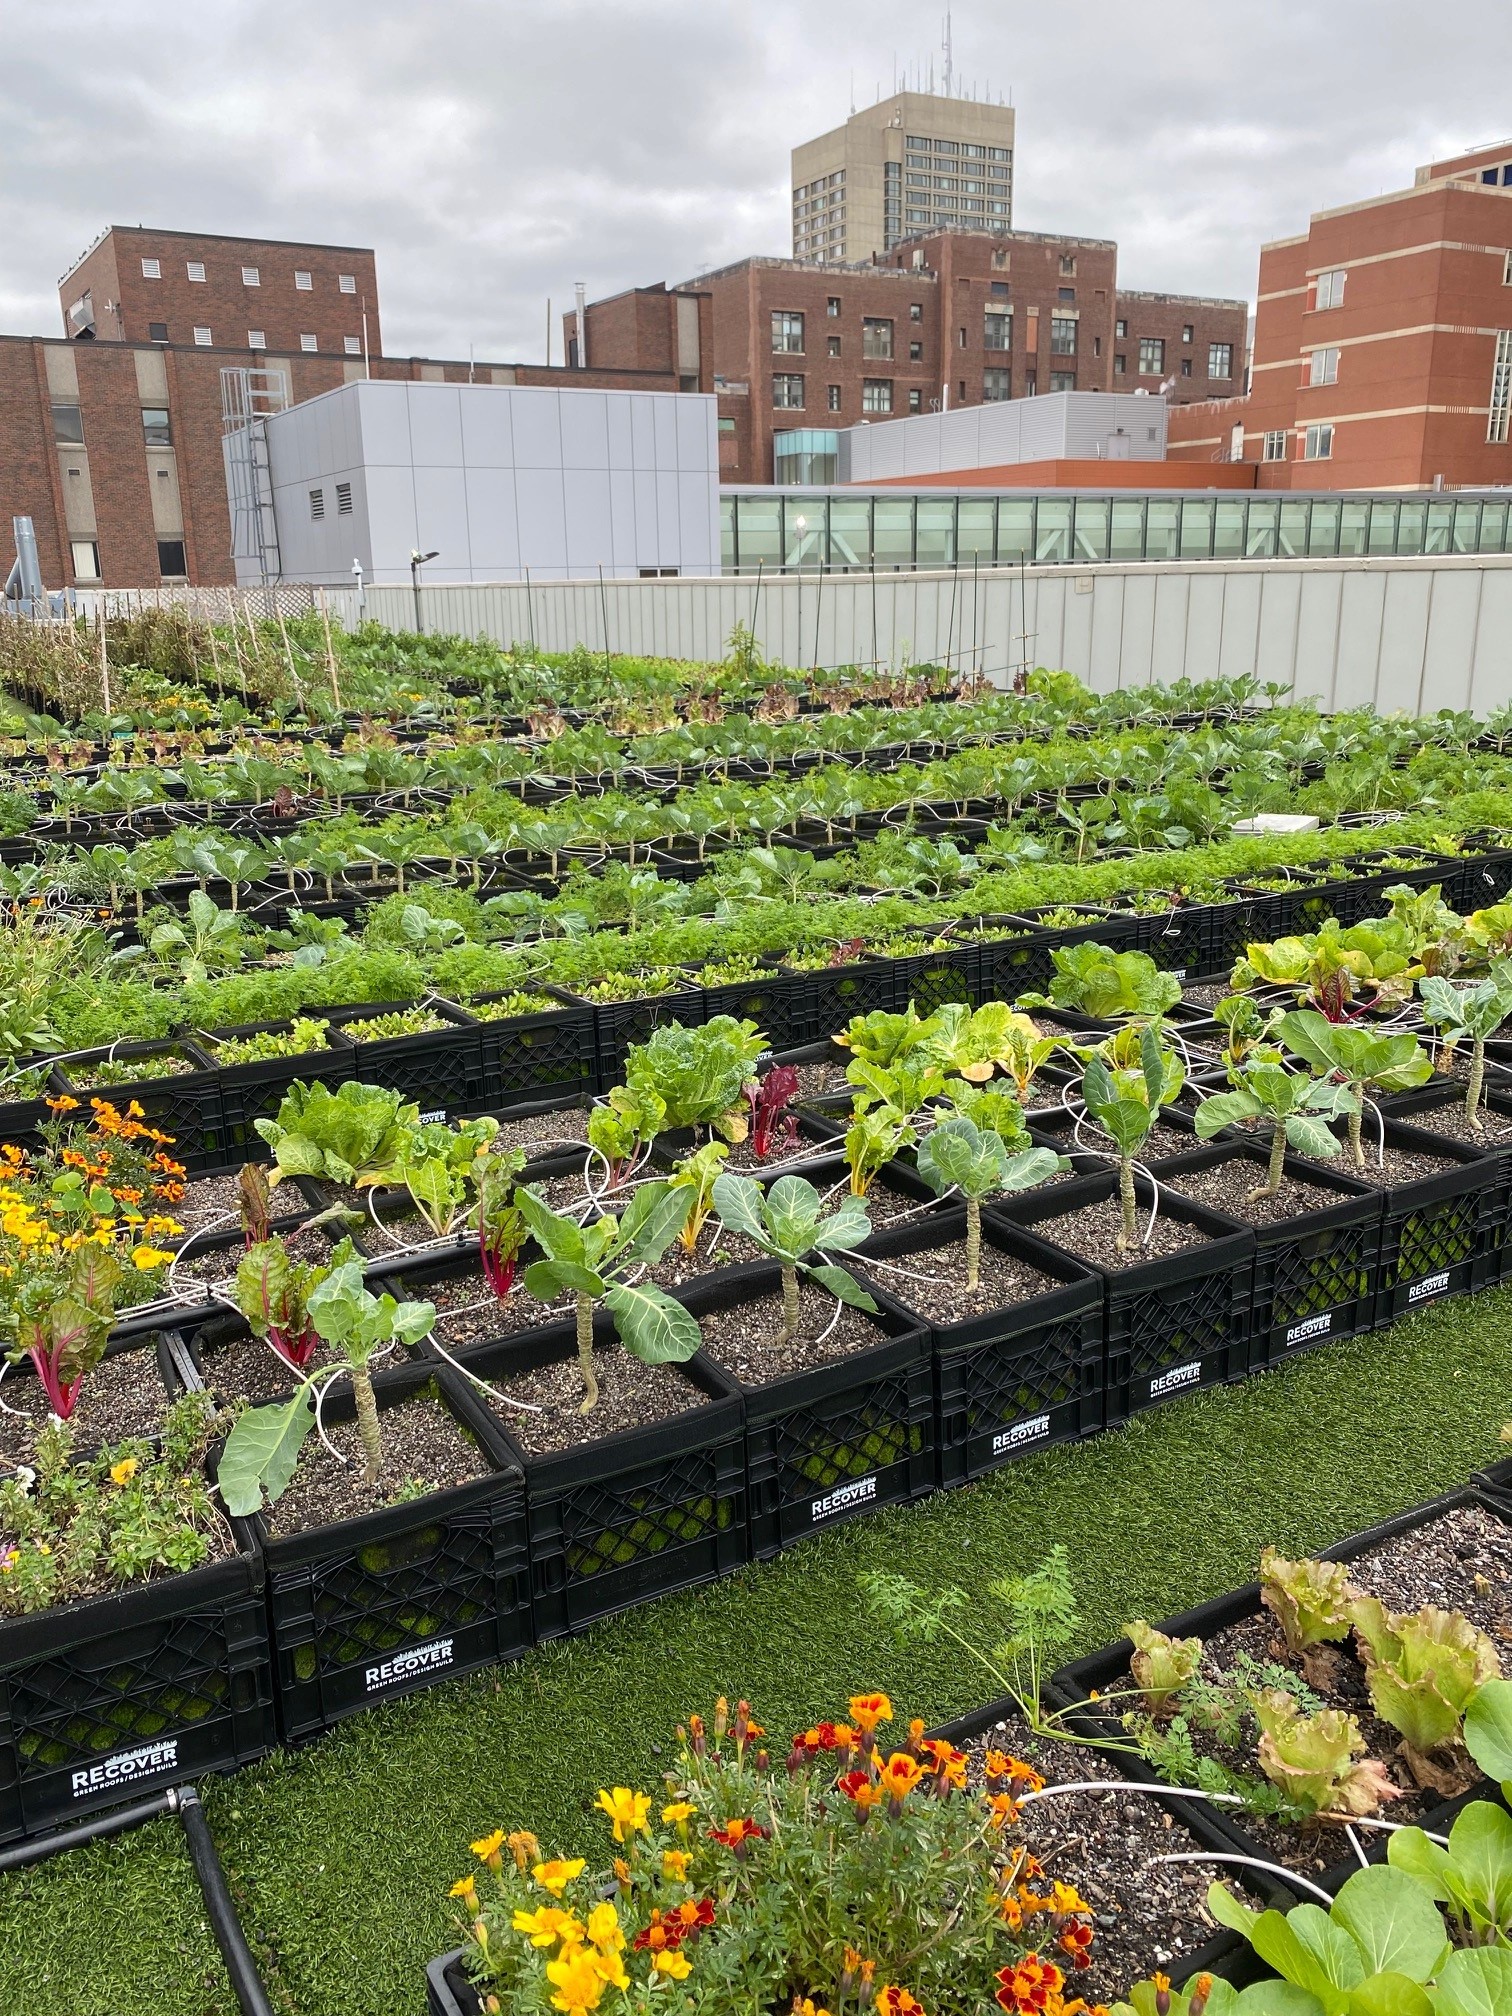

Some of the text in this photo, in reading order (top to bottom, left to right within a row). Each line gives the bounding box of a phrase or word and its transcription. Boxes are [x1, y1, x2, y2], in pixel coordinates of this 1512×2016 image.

[1409, 1277, 1449, 1298] RECOVER
[1287, 1319, 1331, 1341] RECOVER
[1150, 1367, 1200, 1392] RECOVER
[993, 1421, 1049, 1450] RECOVER
[812, 1483, 876, 1516] RECOVER
[365, 1646, 453, 1685] RECOVER
[72, 1748, 177, 1790] RECOVER
[73, 1785, 99, 1798] GREEN
[157, 1761, 178, 1772] BUILD
